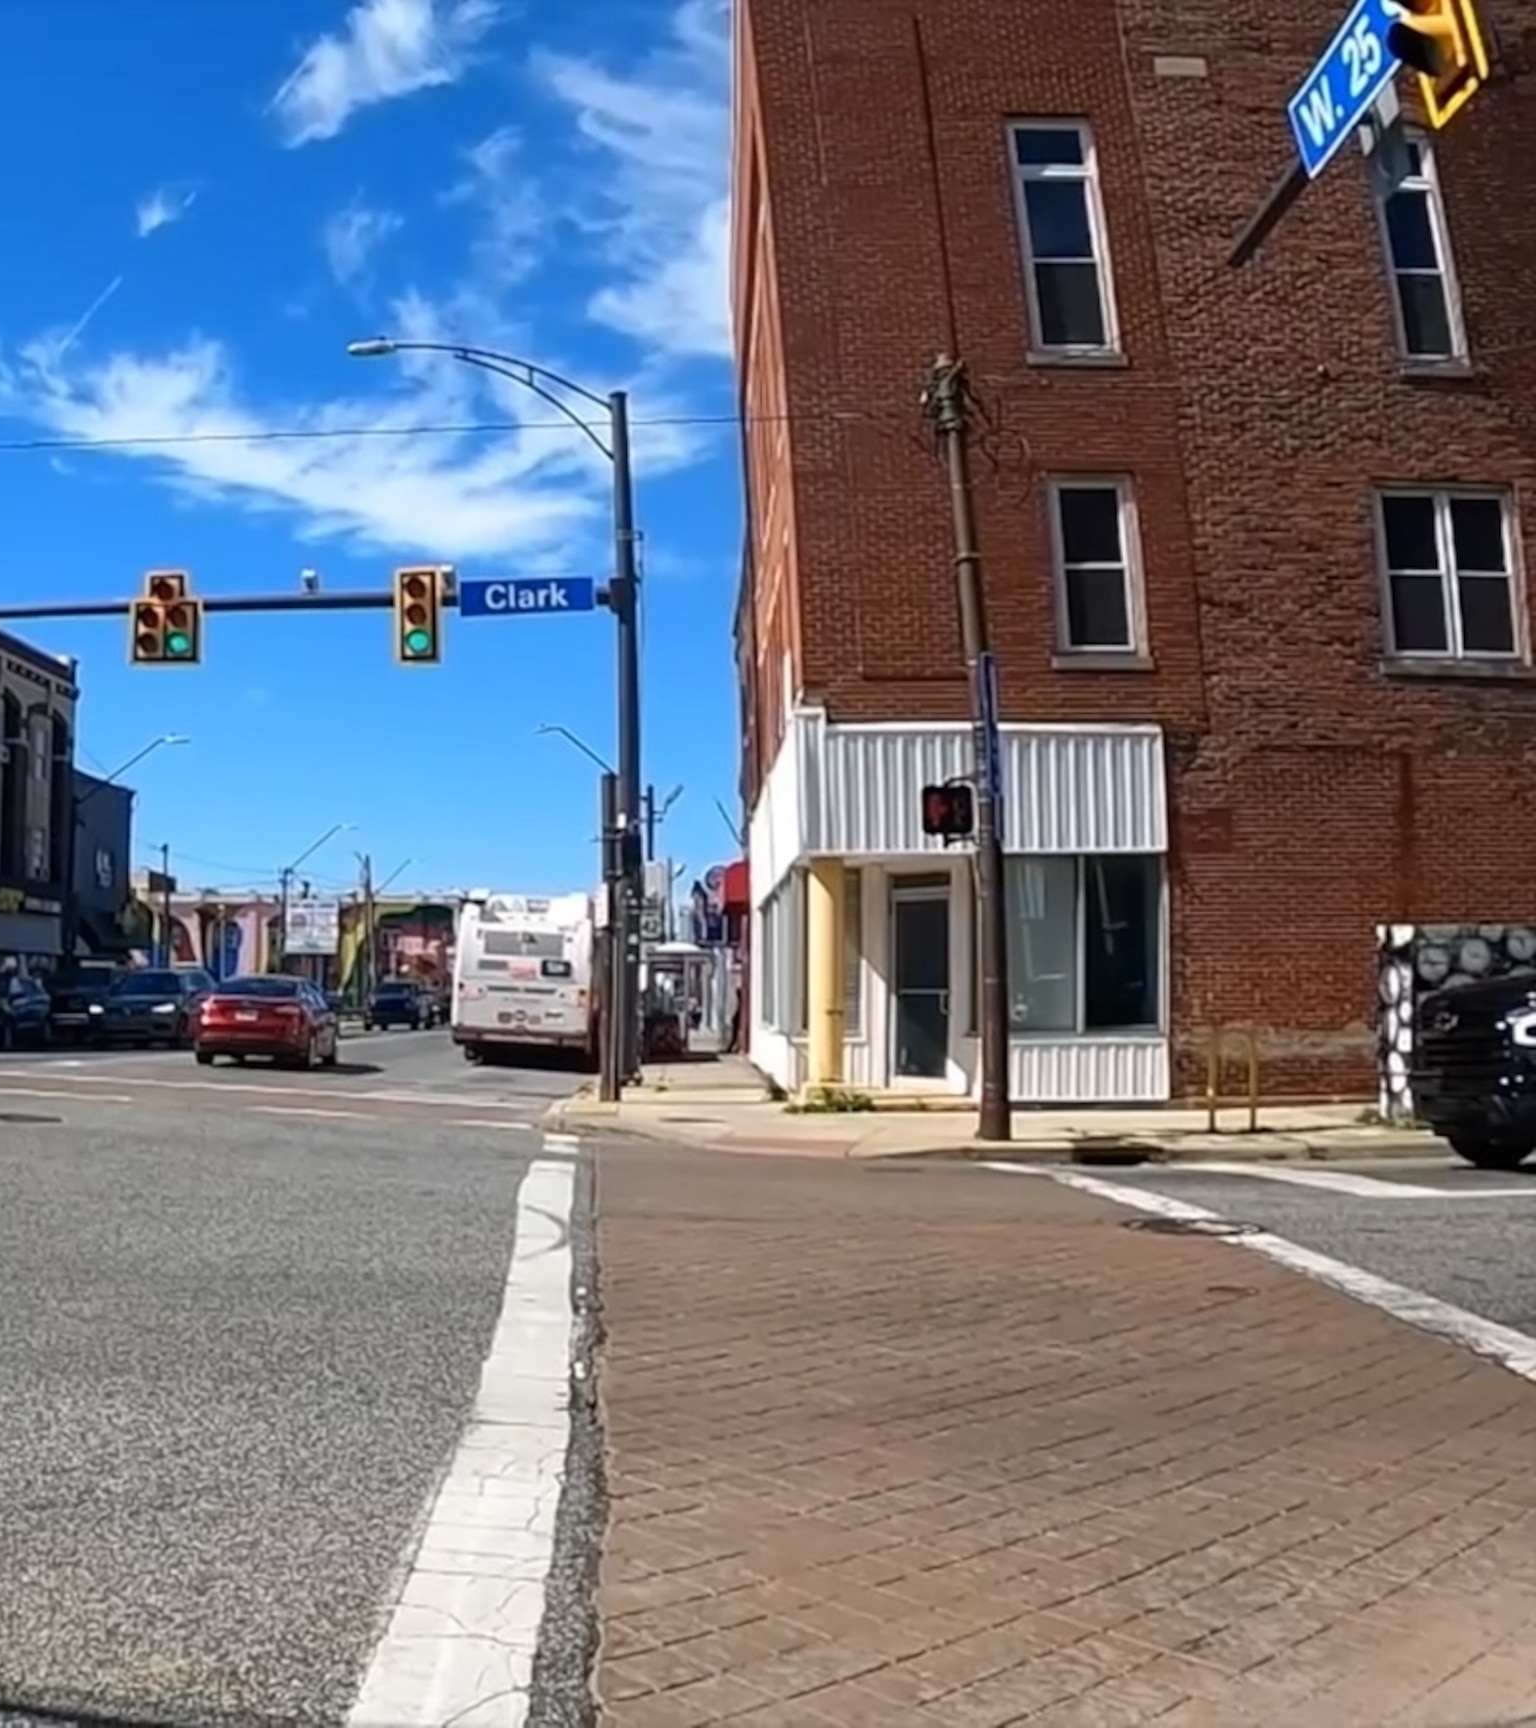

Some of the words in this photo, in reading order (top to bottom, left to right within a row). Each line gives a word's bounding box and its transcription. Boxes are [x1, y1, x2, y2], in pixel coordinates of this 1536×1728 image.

[1298, 74, 1345, 147] W.
[1341, 14, 1382, 99] 25
[484, 582, 569, 610] Clark
